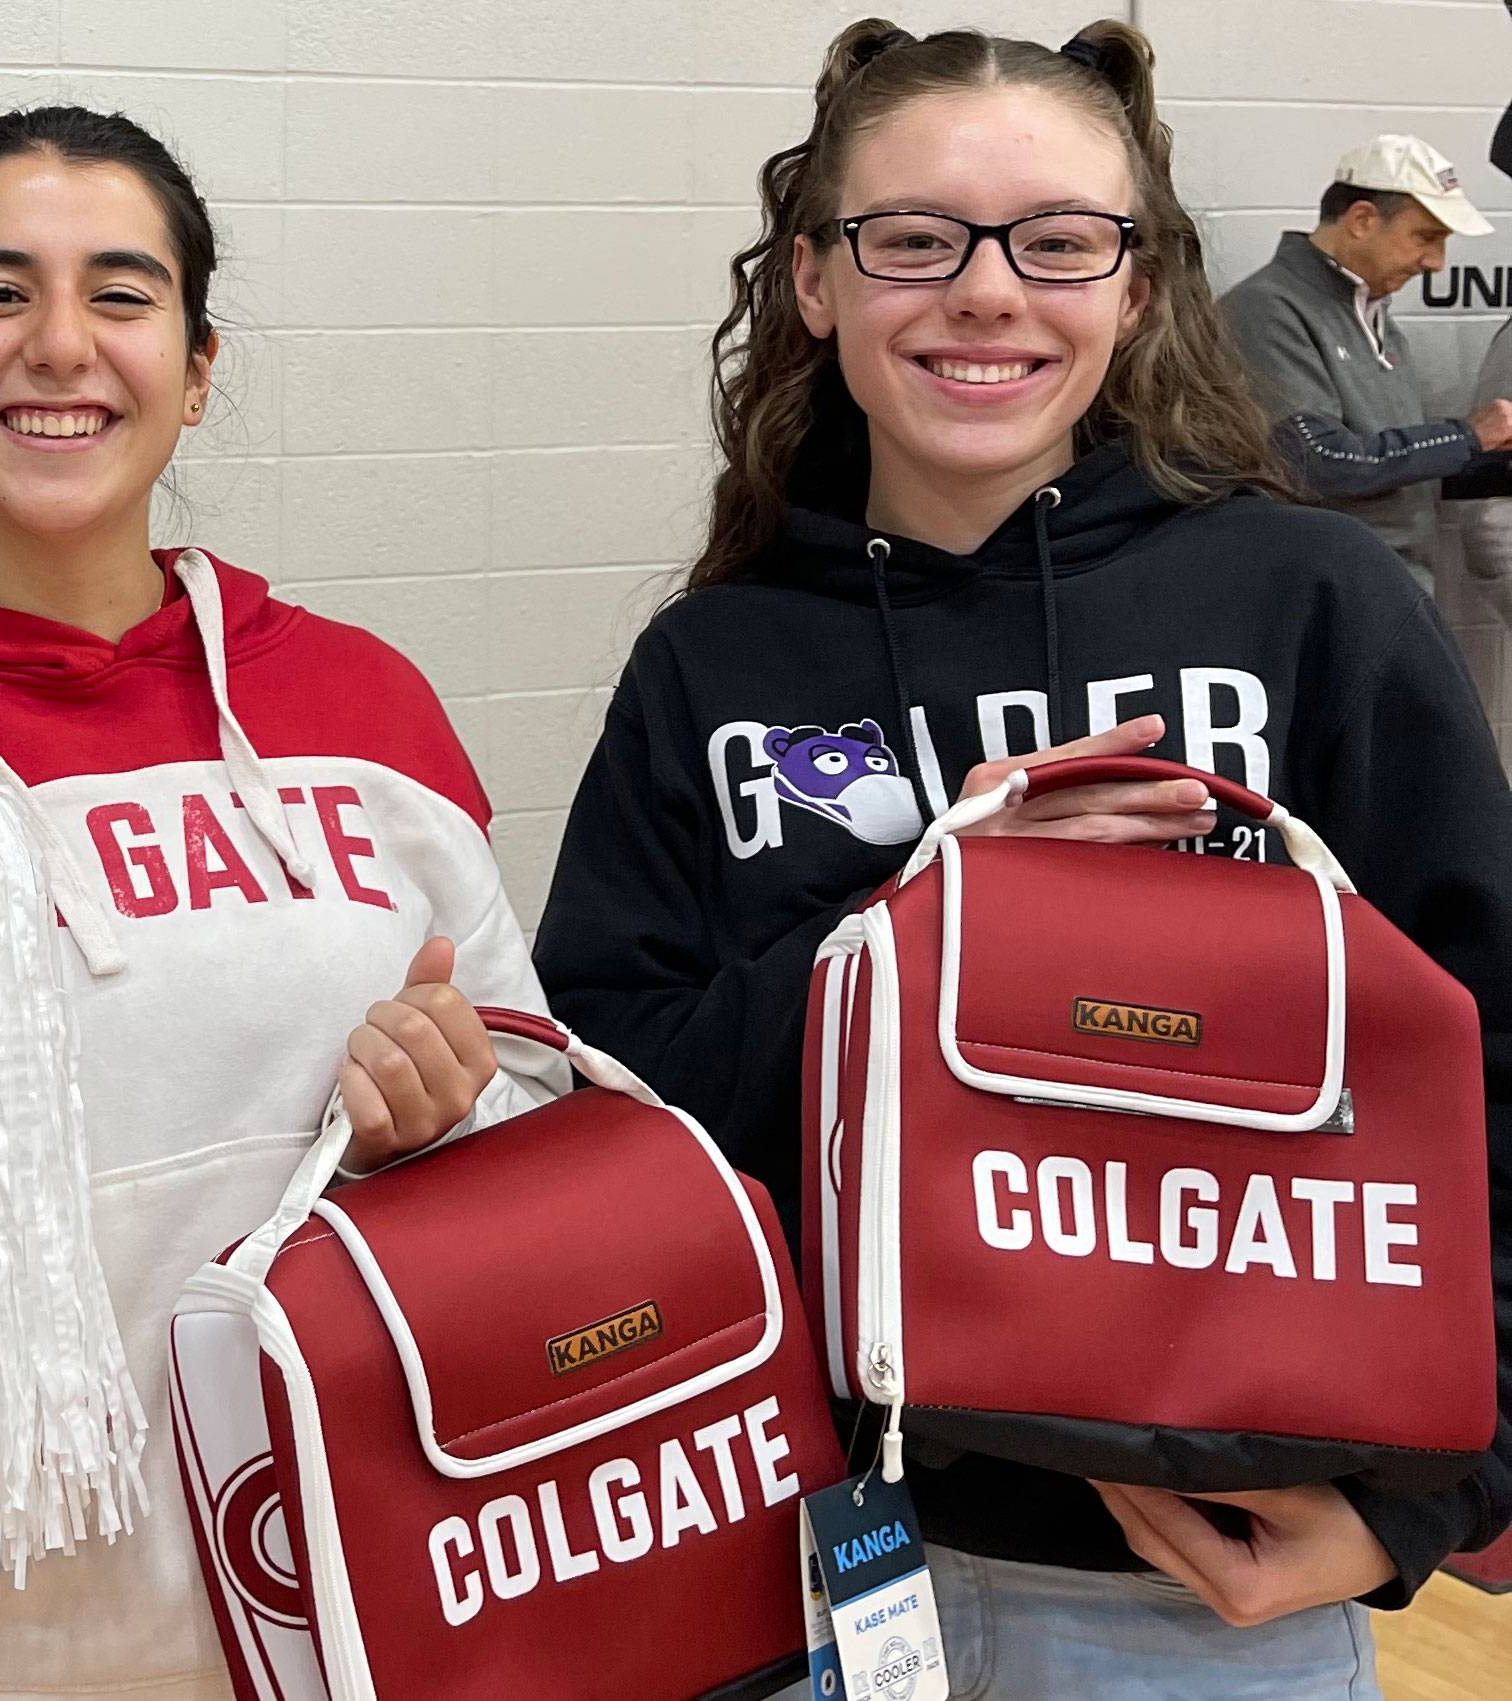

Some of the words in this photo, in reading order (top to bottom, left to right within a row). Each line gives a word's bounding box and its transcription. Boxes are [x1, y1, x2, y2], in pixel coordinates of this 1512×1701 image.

[1078, 1003, 1194, 1040] KANGA
[972, 1149, 1423, 1287] COLGATE
[554, 1311, 658, 1370] KANGA
[428, 1395, 800, 1627] COLGATE
[832, 1520, 911, 1574] KANGA
[855, 1609, 887, 1634] KASE
[888, 1594, 919, 1619] MATE
[875, 1655, 920, 1687] COOLER
